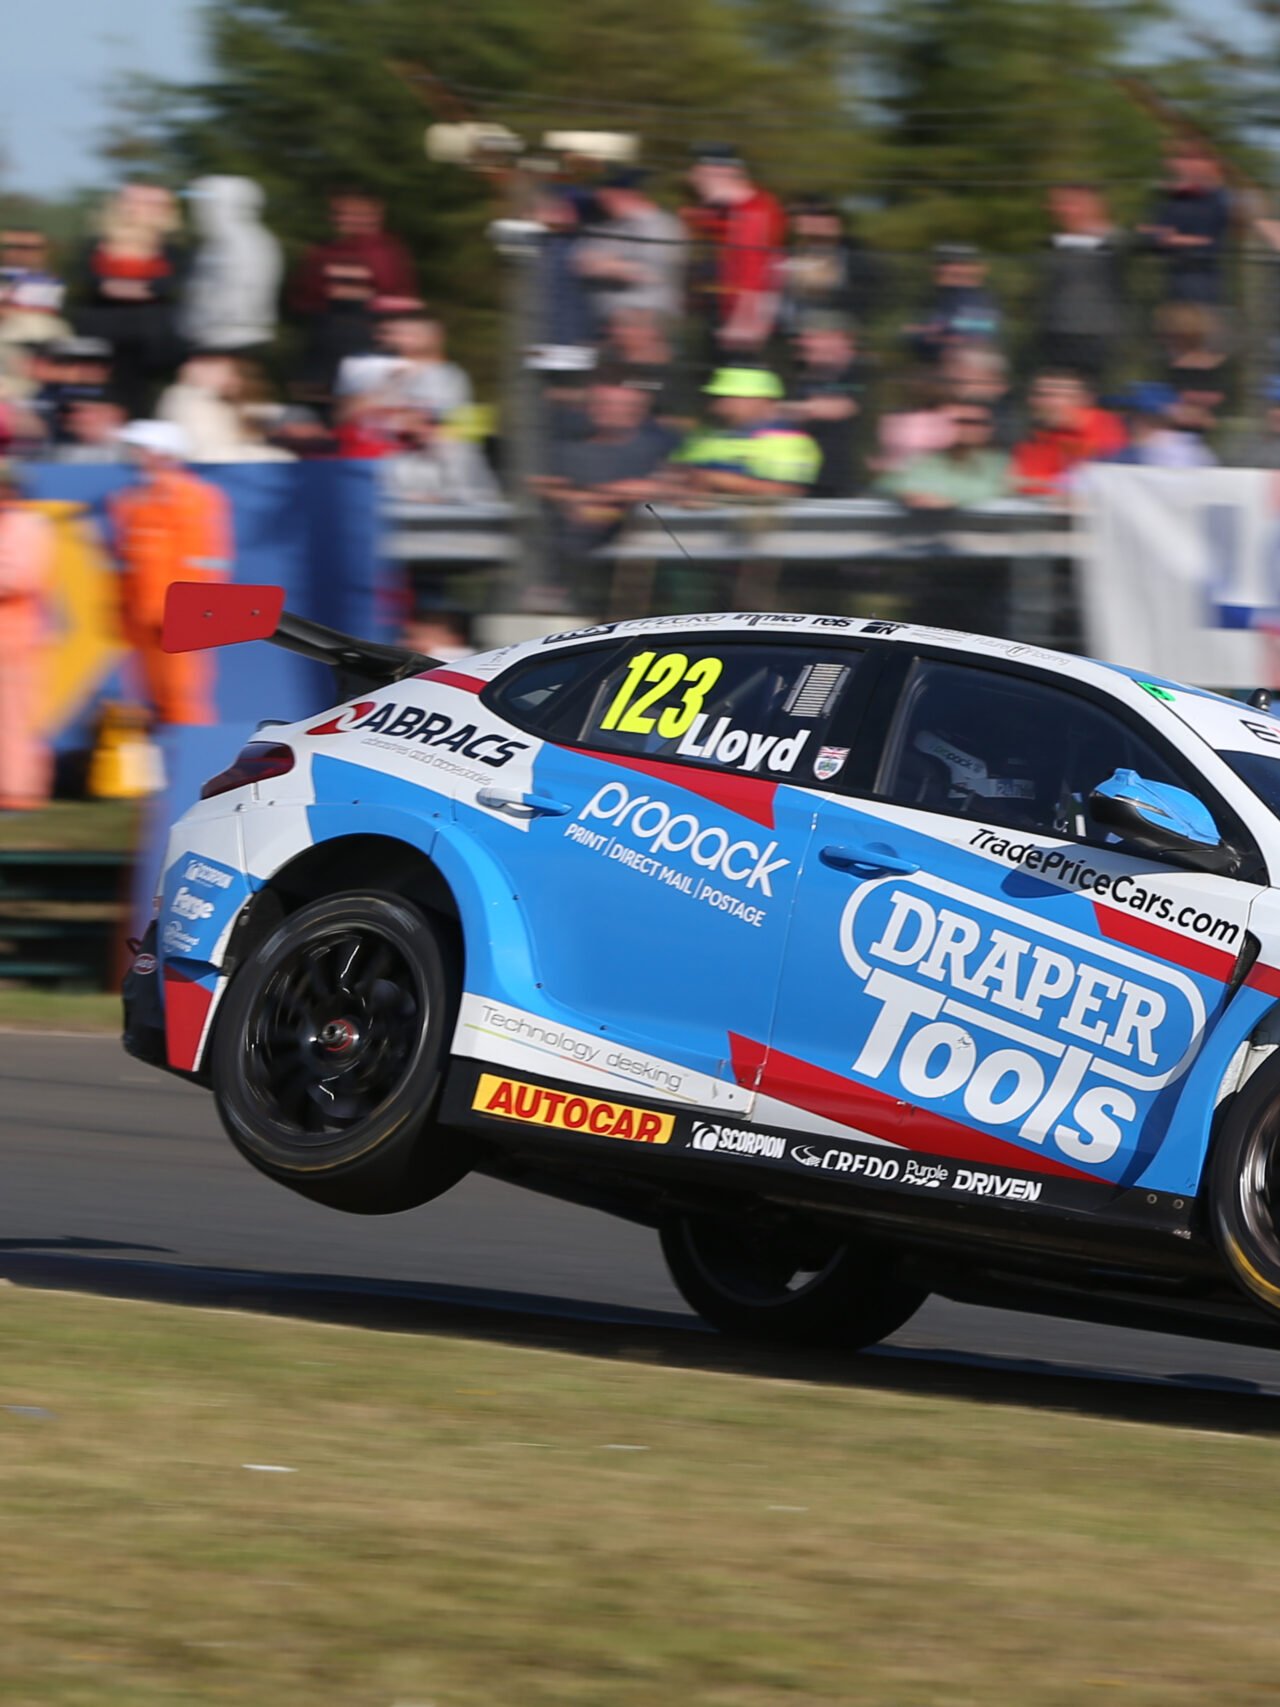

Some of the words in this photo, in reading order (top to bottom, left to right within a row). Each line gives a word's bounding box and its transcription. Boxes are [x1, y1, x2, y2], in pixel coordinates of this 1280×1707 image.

[352, 703, 531, 768] ABRACS
[600, 651, 723, 739] 123
[676, 713, 811, 772] Lloyd
[563, 823, 608, 852] PRINT
[609, 843, 662, 878] DIRECT
[657, 866, 693, 895] MAIL
[699, 886, 767, 928] POSTAGE
[578, 782, 791, 898] propack
[968, 827, 1240, 945] TradePriceCars.com
[869, 890, 1172, 1067] DRAPER
[482, 1005, 601, 1061] Technology
[606, 1051, 683, 1093] desking
[851, 967, 1137, 1164] Tools
[486, 1081, 662, 1143] AUTOCAR
[719, 1127, 787, 1160] SCORPION
[905, 1160, 949, 1181] Purple
[952, 1169, 1043, 1201] DRIVEN
